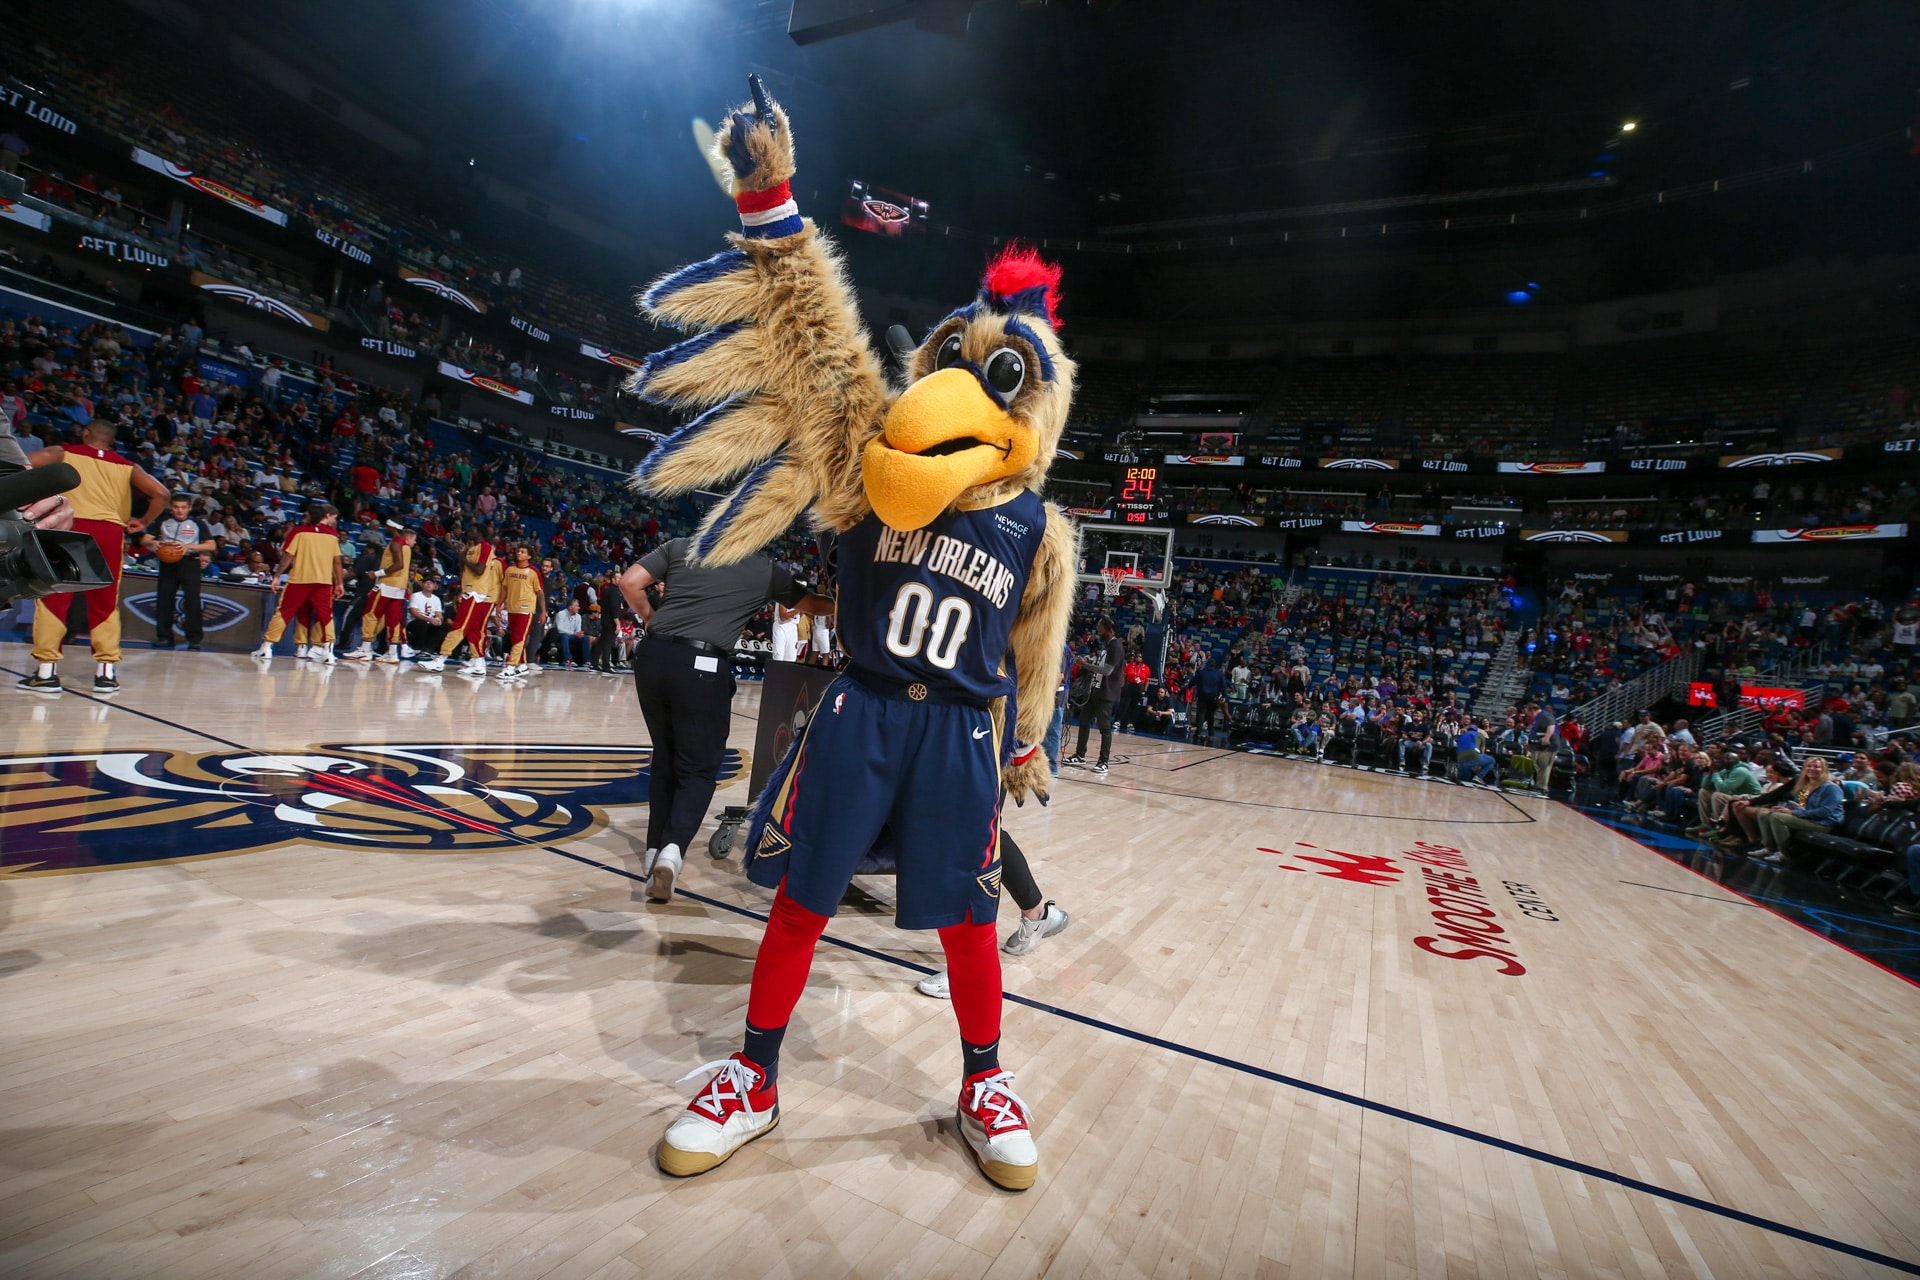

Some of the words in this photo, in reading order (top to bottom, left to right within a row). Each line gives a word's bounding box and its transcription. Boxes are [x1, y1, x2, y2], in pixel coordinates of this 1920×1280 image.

[0, 85, 24, 108] ET
[1127, 468, 1156, 480] 12:00
[1122, 480, 1153, 500] 24
[994, 513, 1030, 536] NEWAGE
[997, 523, 1022, 540] GARAGE
[873, 526, 931, 566] NEW
[927, 534, 1015, 610] ORLEANS
[885, 582, 973, 670] 00
[1402, 842, 1472, 874] KING
[1501, 880, 1560, 922] CENTER
[1413, 867, 1526, 976] SMOOTHIE
